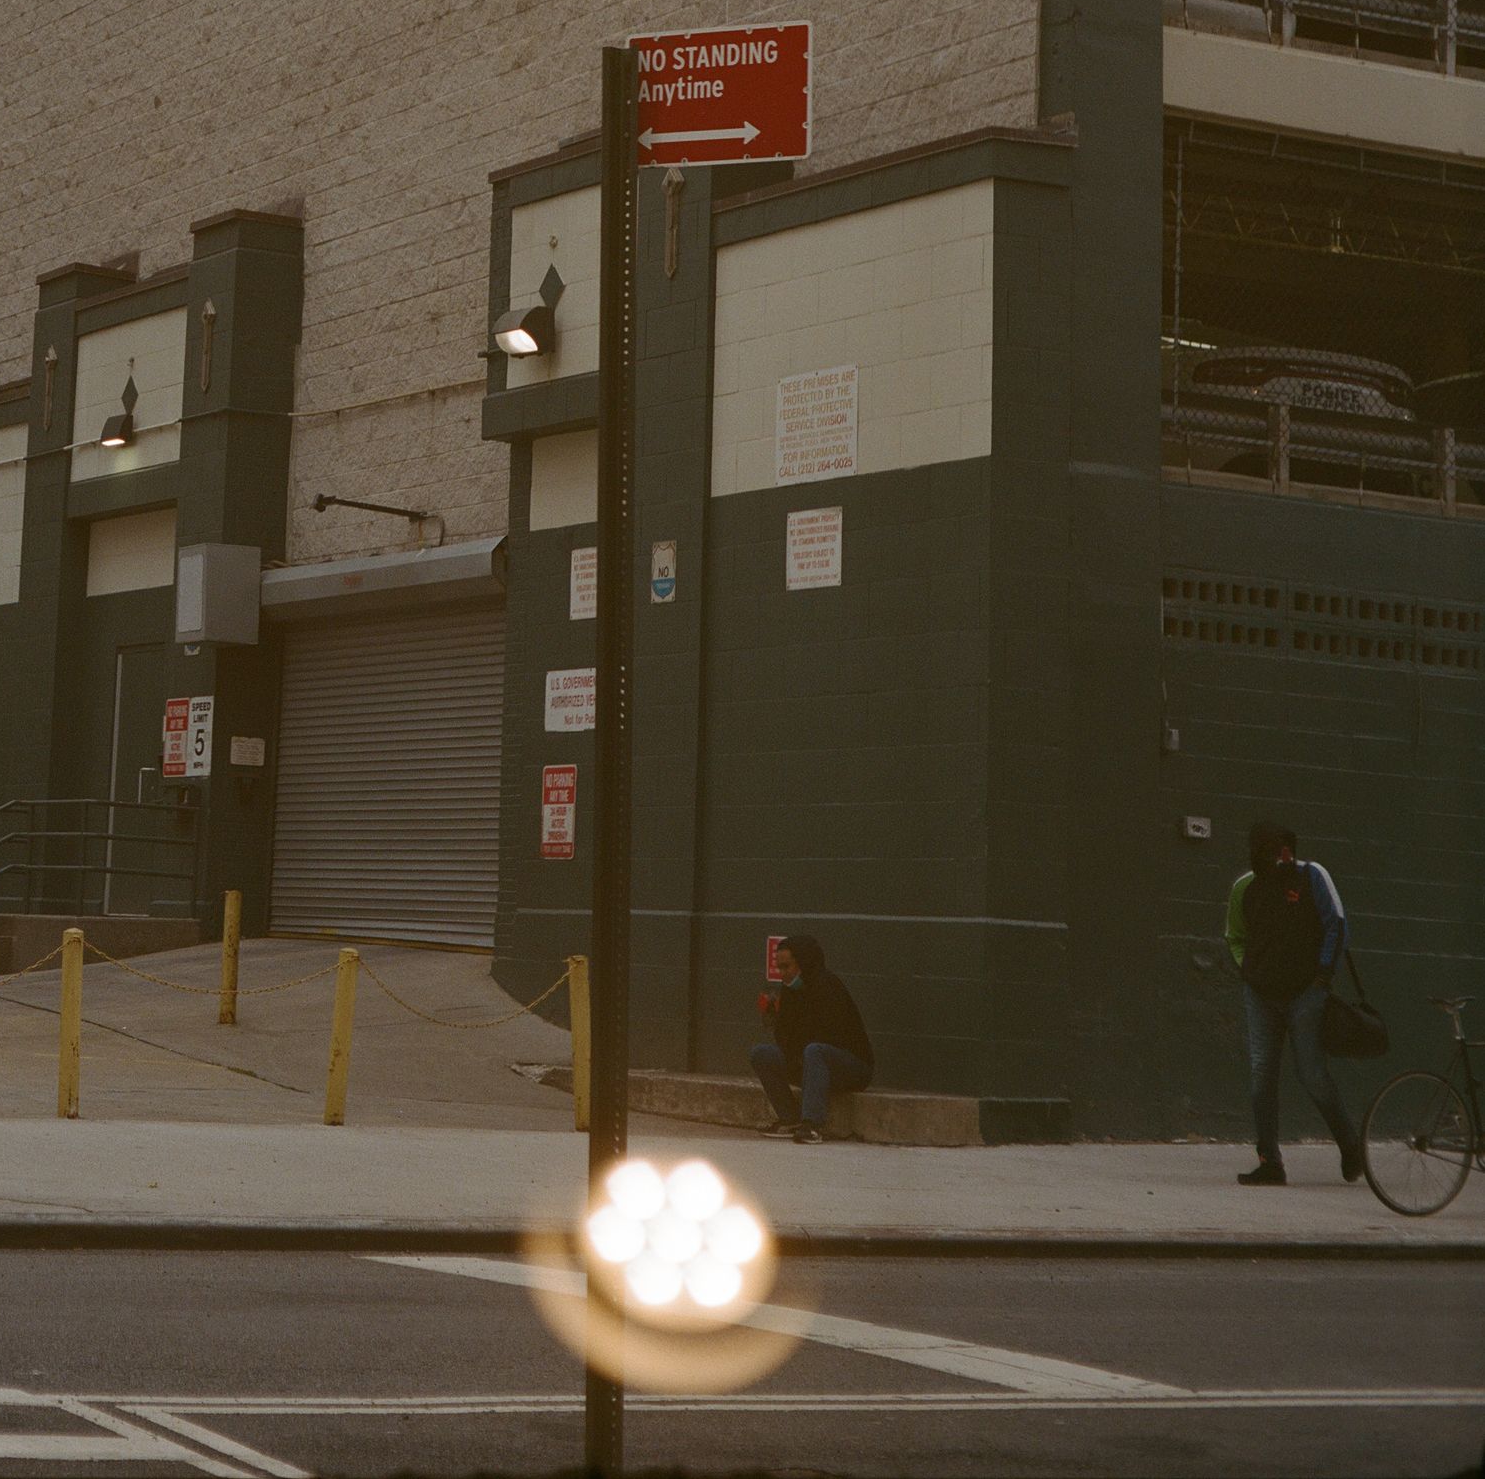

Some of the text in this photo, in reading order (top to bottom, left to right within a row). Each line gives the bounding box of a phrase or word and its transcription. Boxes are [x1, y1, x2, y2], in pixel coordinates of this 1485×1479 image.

[638, 39, 779, 72] NO STANDING
[637, 75, 724, 107] Anytime
[780, 369, 856, 395] THESE PREMISES ARE
[783, 384, 851, 407] PROTECTED BY THE
[1302, 383, 1360, 404] POLICE
[811, 398, 853, 415] PROTECTIVE
[785, 413, 848, 433] SERVICE DIVISION
[783, 451, 798, 465] FOR
[779, 465, 797, 478] CALL
[658, 566, 669, 578] NO
[562, 675, 596, 690] GOVERNME
[192, 702, 212, 712] SPEED
[193, 714, 209, 723] LIMIT
[194, 728, 206, 757] 5
[193, 762, 204, 770] MPH
[545, 772, 575, 788] NO PARKING
